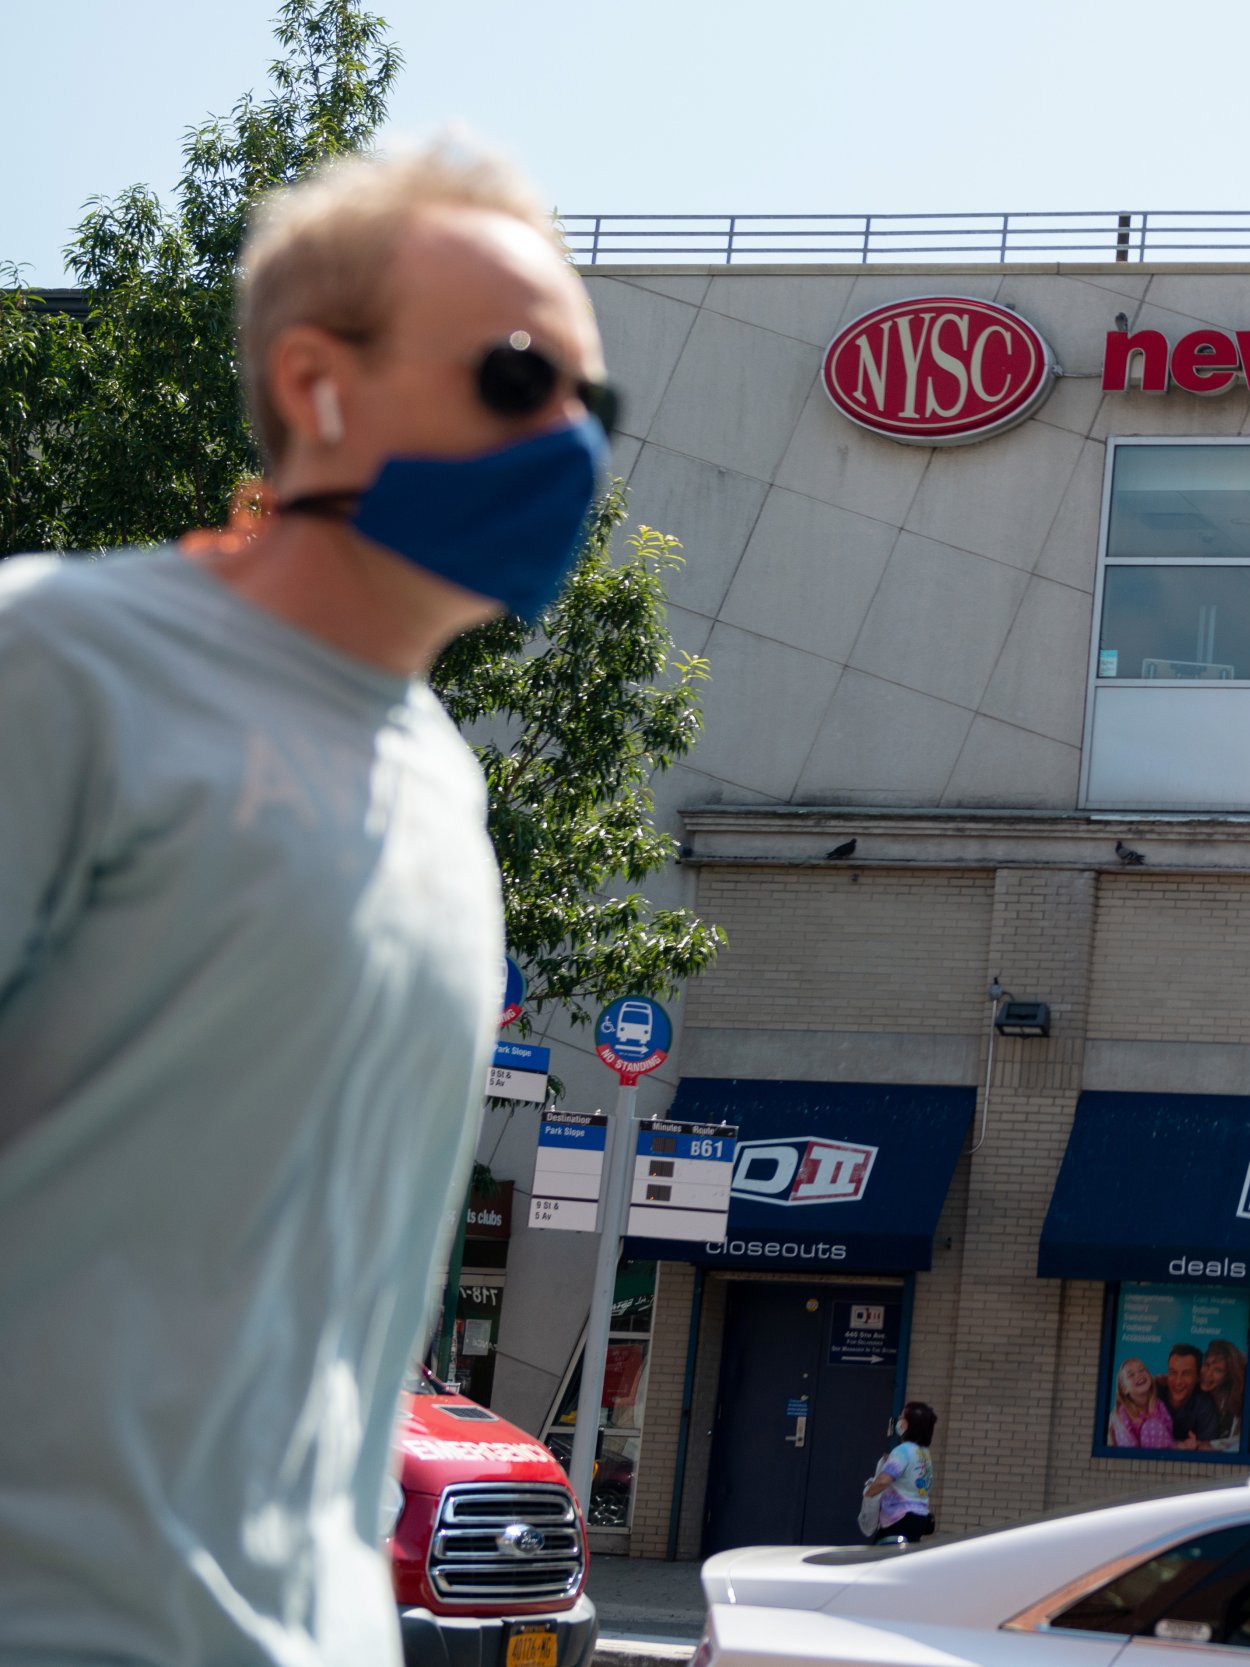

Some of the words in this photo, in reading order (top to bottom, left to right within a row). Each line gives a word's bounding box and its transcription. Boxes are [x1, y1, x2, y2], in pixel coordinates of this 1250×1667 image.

[853, 313, 1012, 418] NYSC
[601, 1048, 616, 1063] NO
[615, 1055, 662, 1072] STANDING
[547, 1112, 592, 1125] Destination
[545, 1126, 561, 1136] Park
[564, 1127, 585, 1138] Slope
[652, 1122, 682, 1133] Minutes
[692, 1125, 715, 1136] Route
[690, 1139, 723, 1158] B61
[543, 1201, 552, 1210] St
[553, 1202, 559, 1210] &
[477, 1209, 502, 1227] clubs
[541, 1212, 552, 1221] Av
[706, 1237, 847, 1259] closeouts
[1169, 1256, 1247, 1277] deals
